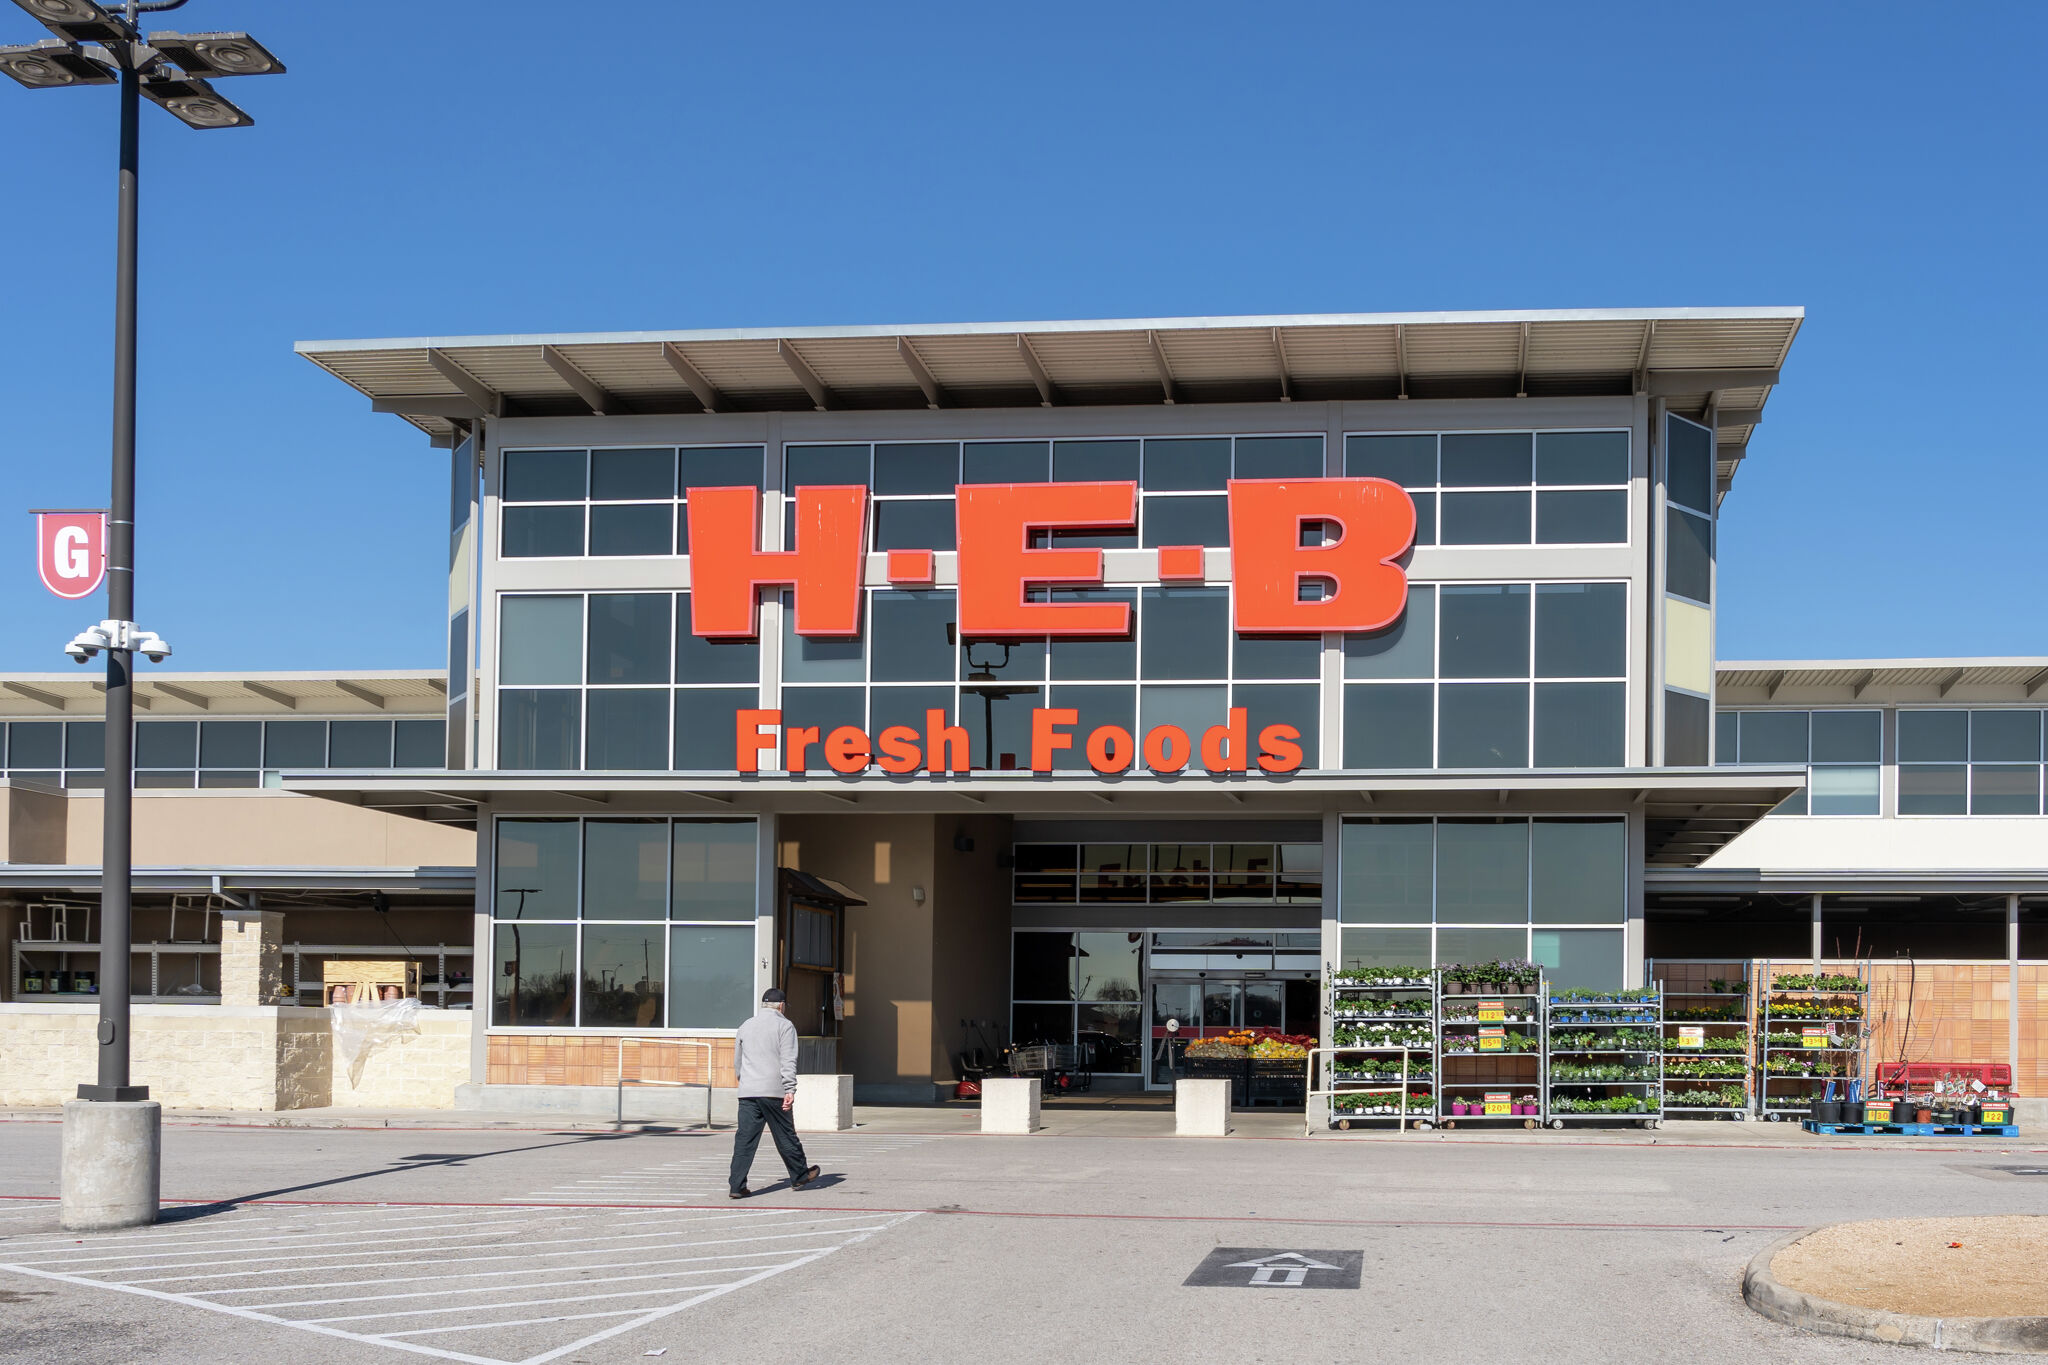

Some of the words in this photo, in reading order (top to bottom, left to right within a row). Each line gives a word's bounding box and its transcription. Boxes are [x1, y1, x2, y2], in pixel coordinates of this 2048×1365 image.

[54, 526, 89, 579] G
[736, 708, 970, 773] Fresh
[1031, 707, 1303, 773] Foods
